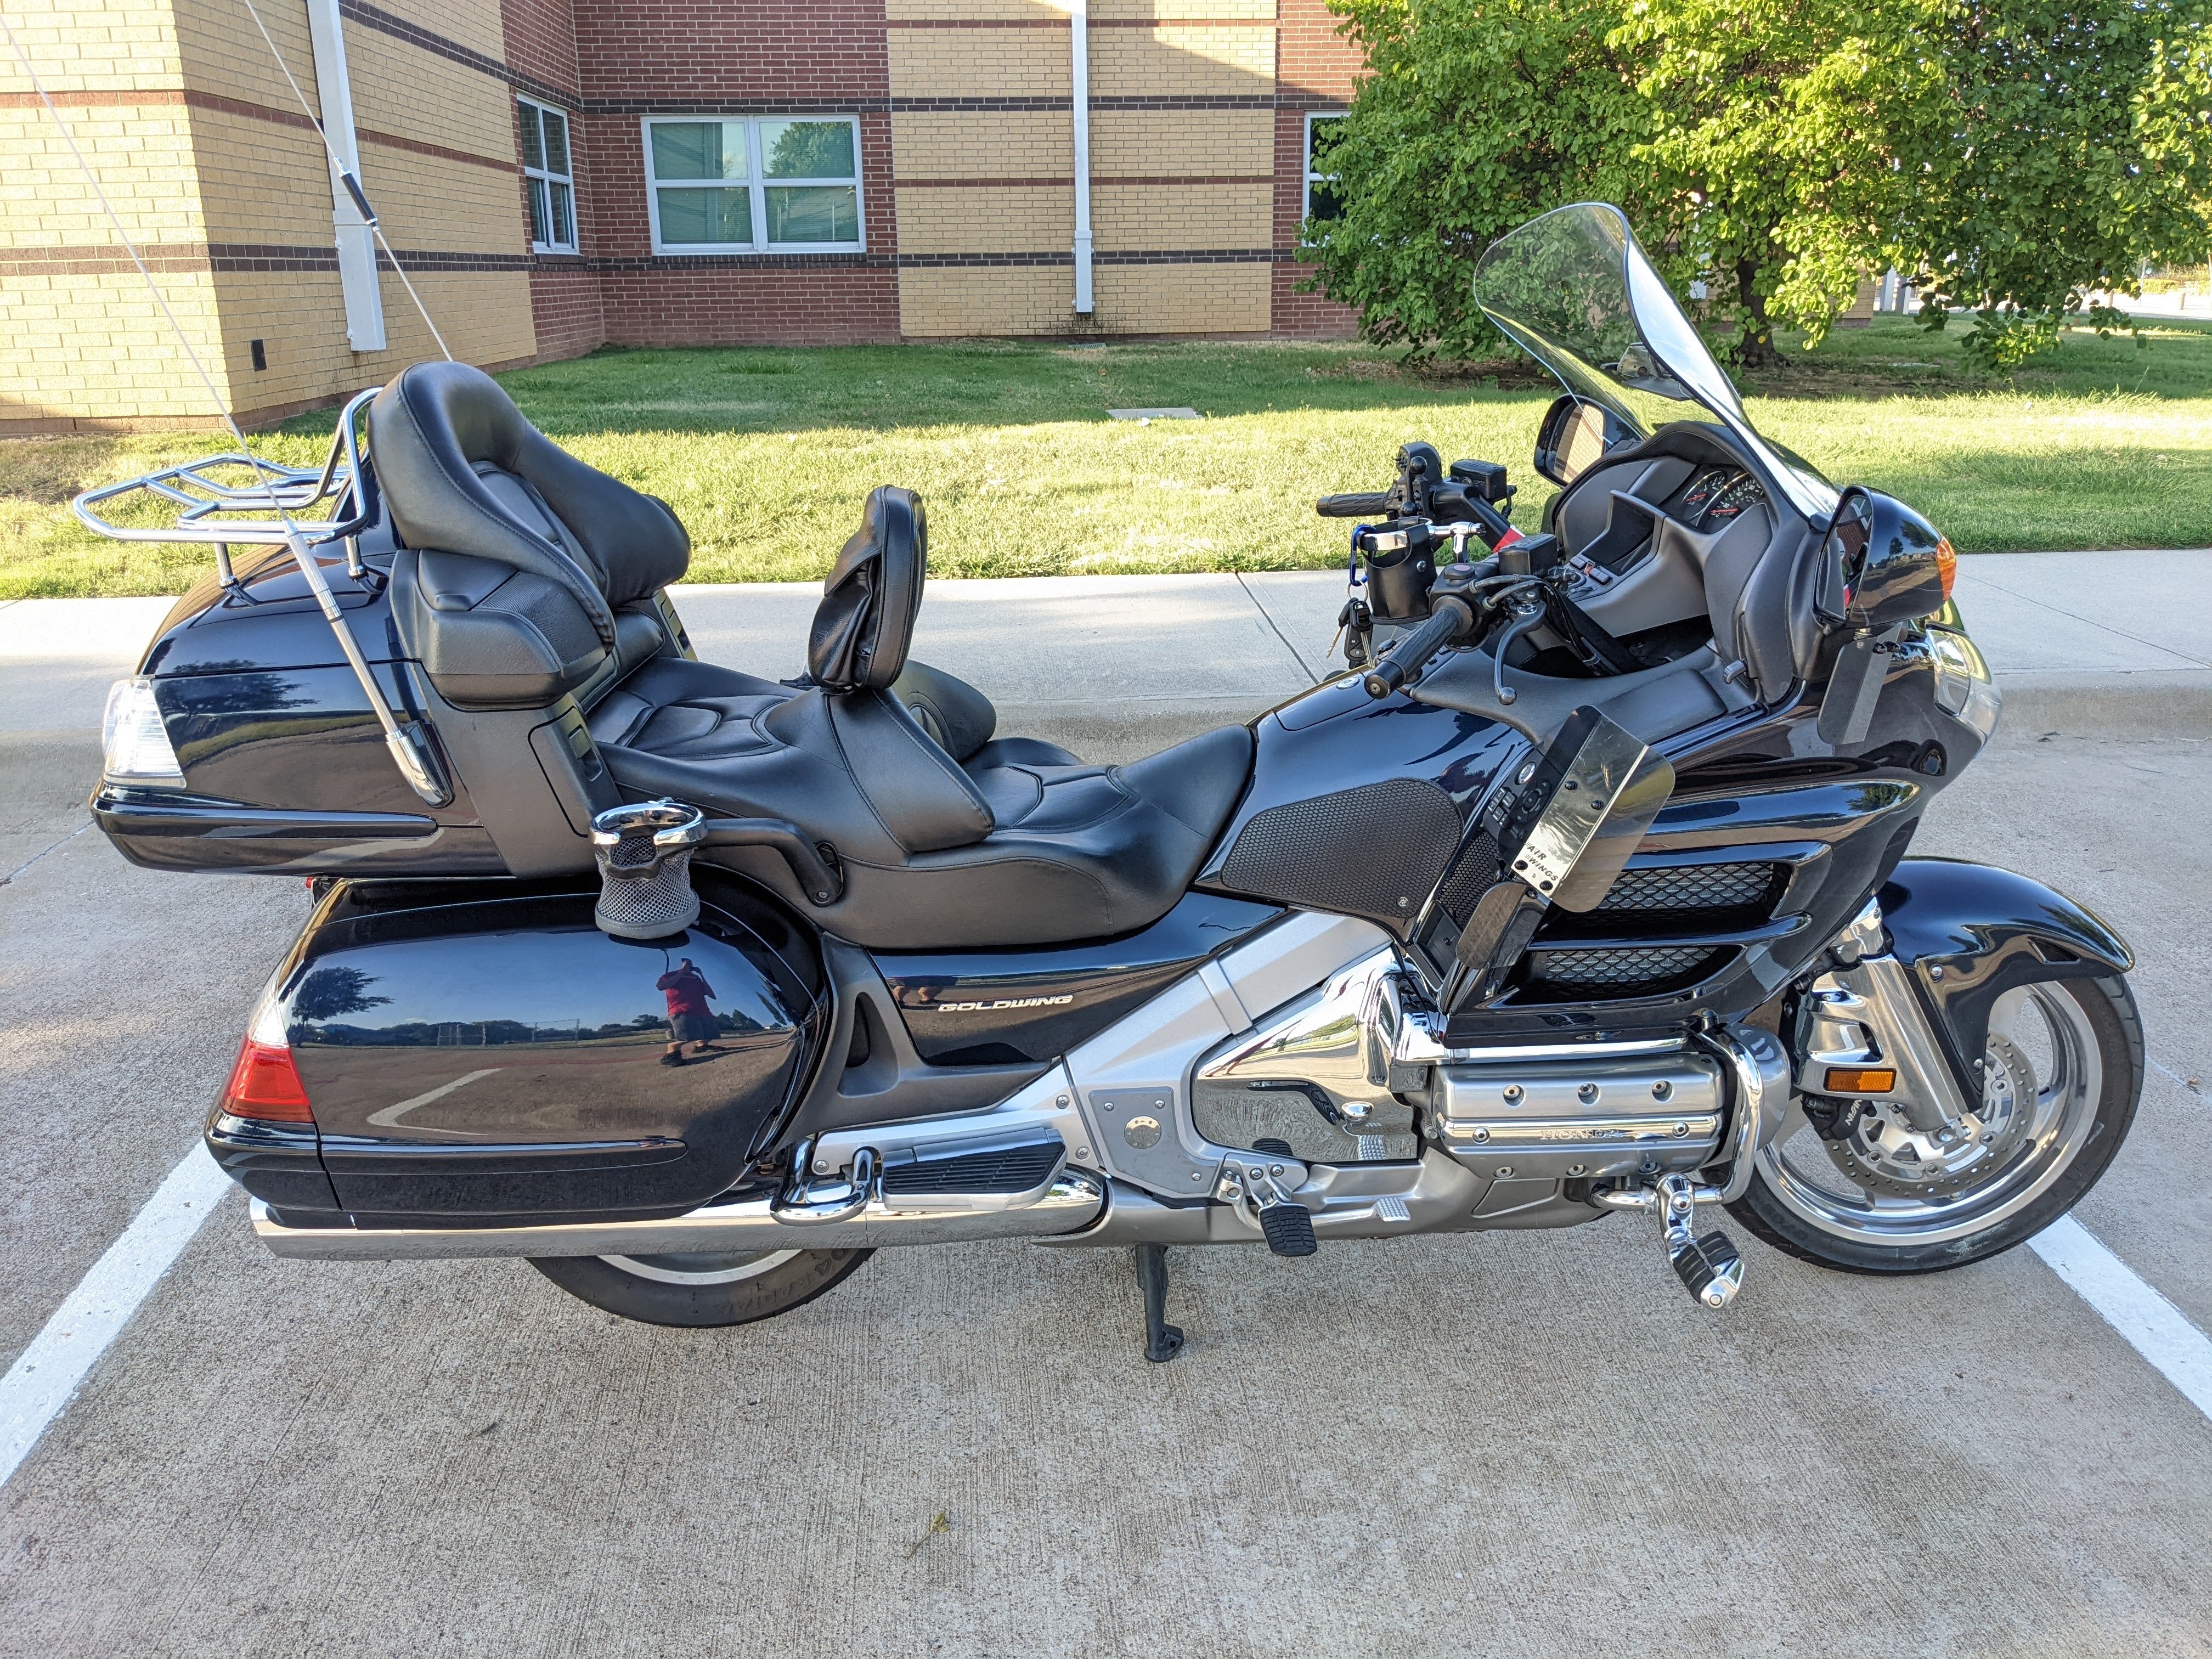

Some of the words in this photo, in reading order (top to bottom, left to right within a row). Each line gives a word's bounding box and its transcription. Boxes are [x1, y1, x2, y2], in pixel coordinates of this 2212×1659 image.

[1527, 845, 1547, 861] AIR
[1528, 857, 1559, 881] WINGS
[938, 994, 1074, 1013] GOLDWING
[1844, 1099, 1862, 1126] NISSIN
[1539, 1129, 1624, 1140] HONDA
